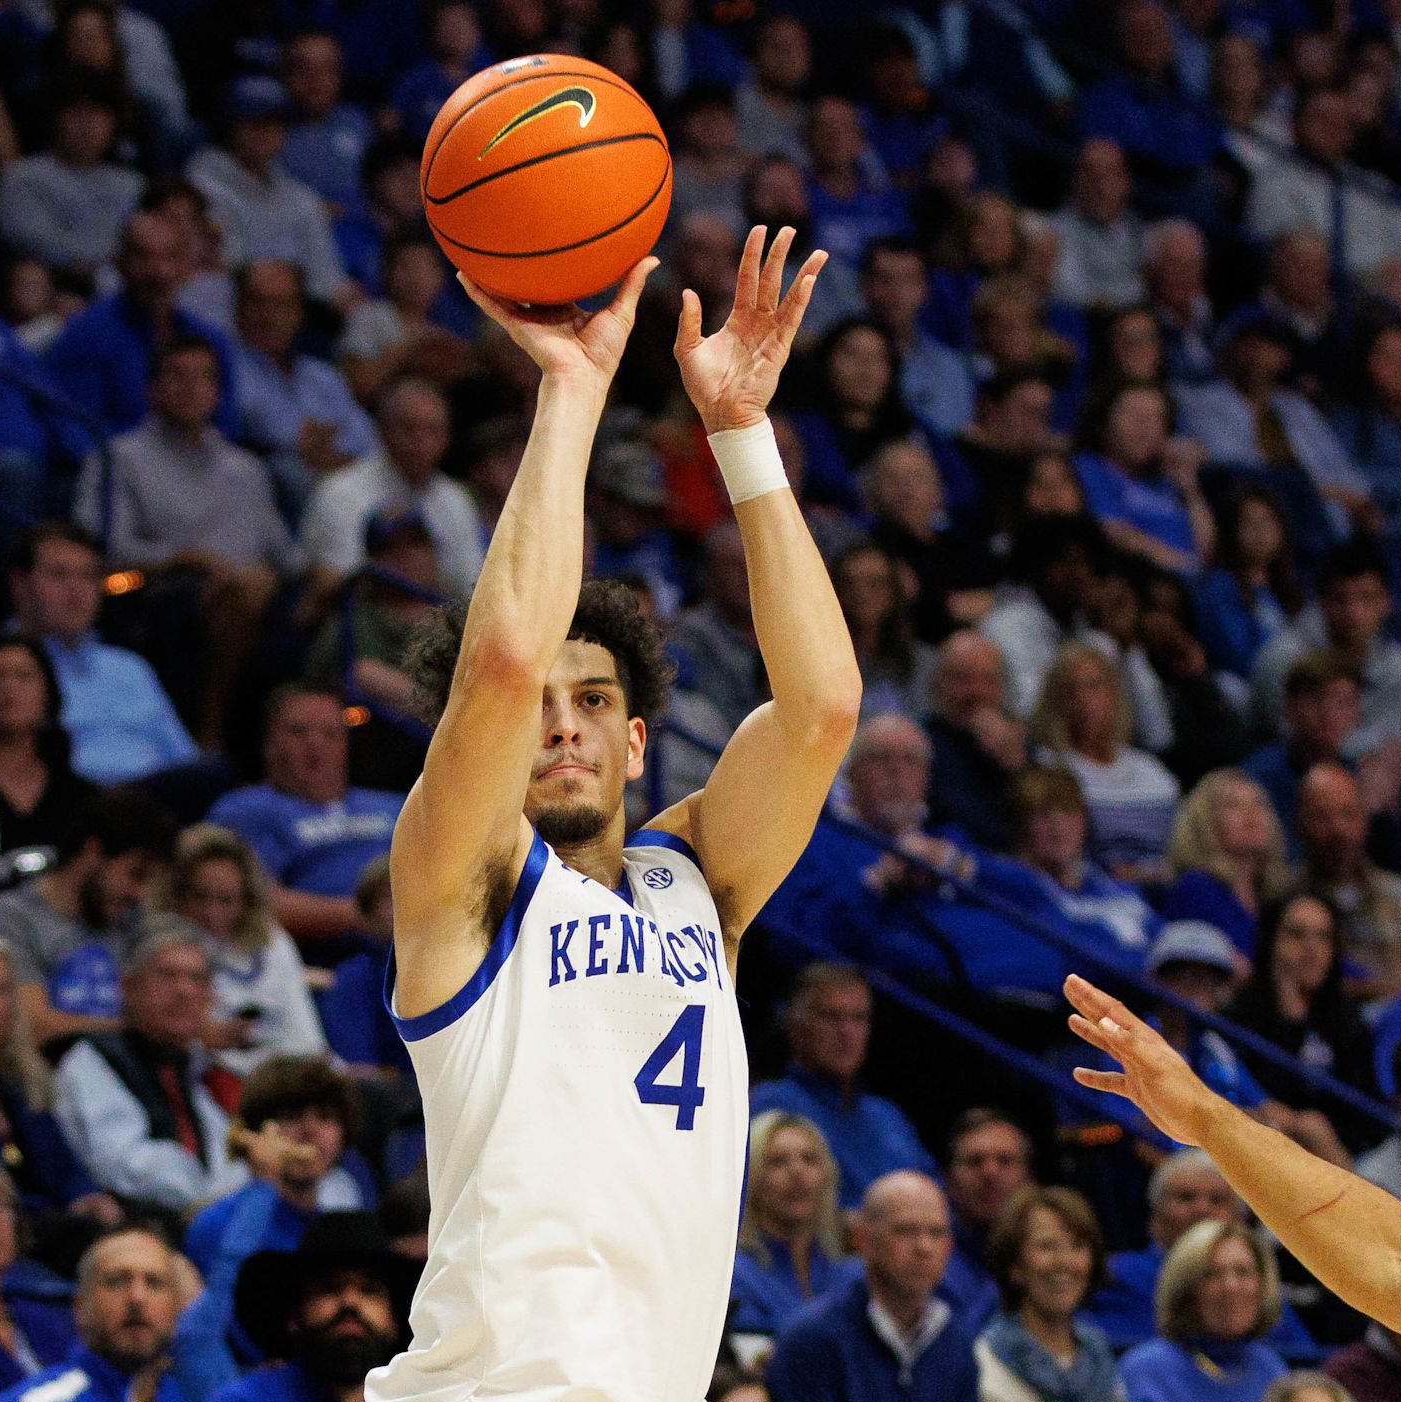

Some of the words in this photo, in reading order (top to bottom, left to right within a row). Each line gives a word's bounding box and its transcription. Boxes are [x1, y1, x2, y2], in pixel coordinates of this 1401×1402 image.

[643, 867, 674, 890] SEC
[549, 914, 724, 991] KENCY
[633, 1004, 706, 1131] 4
